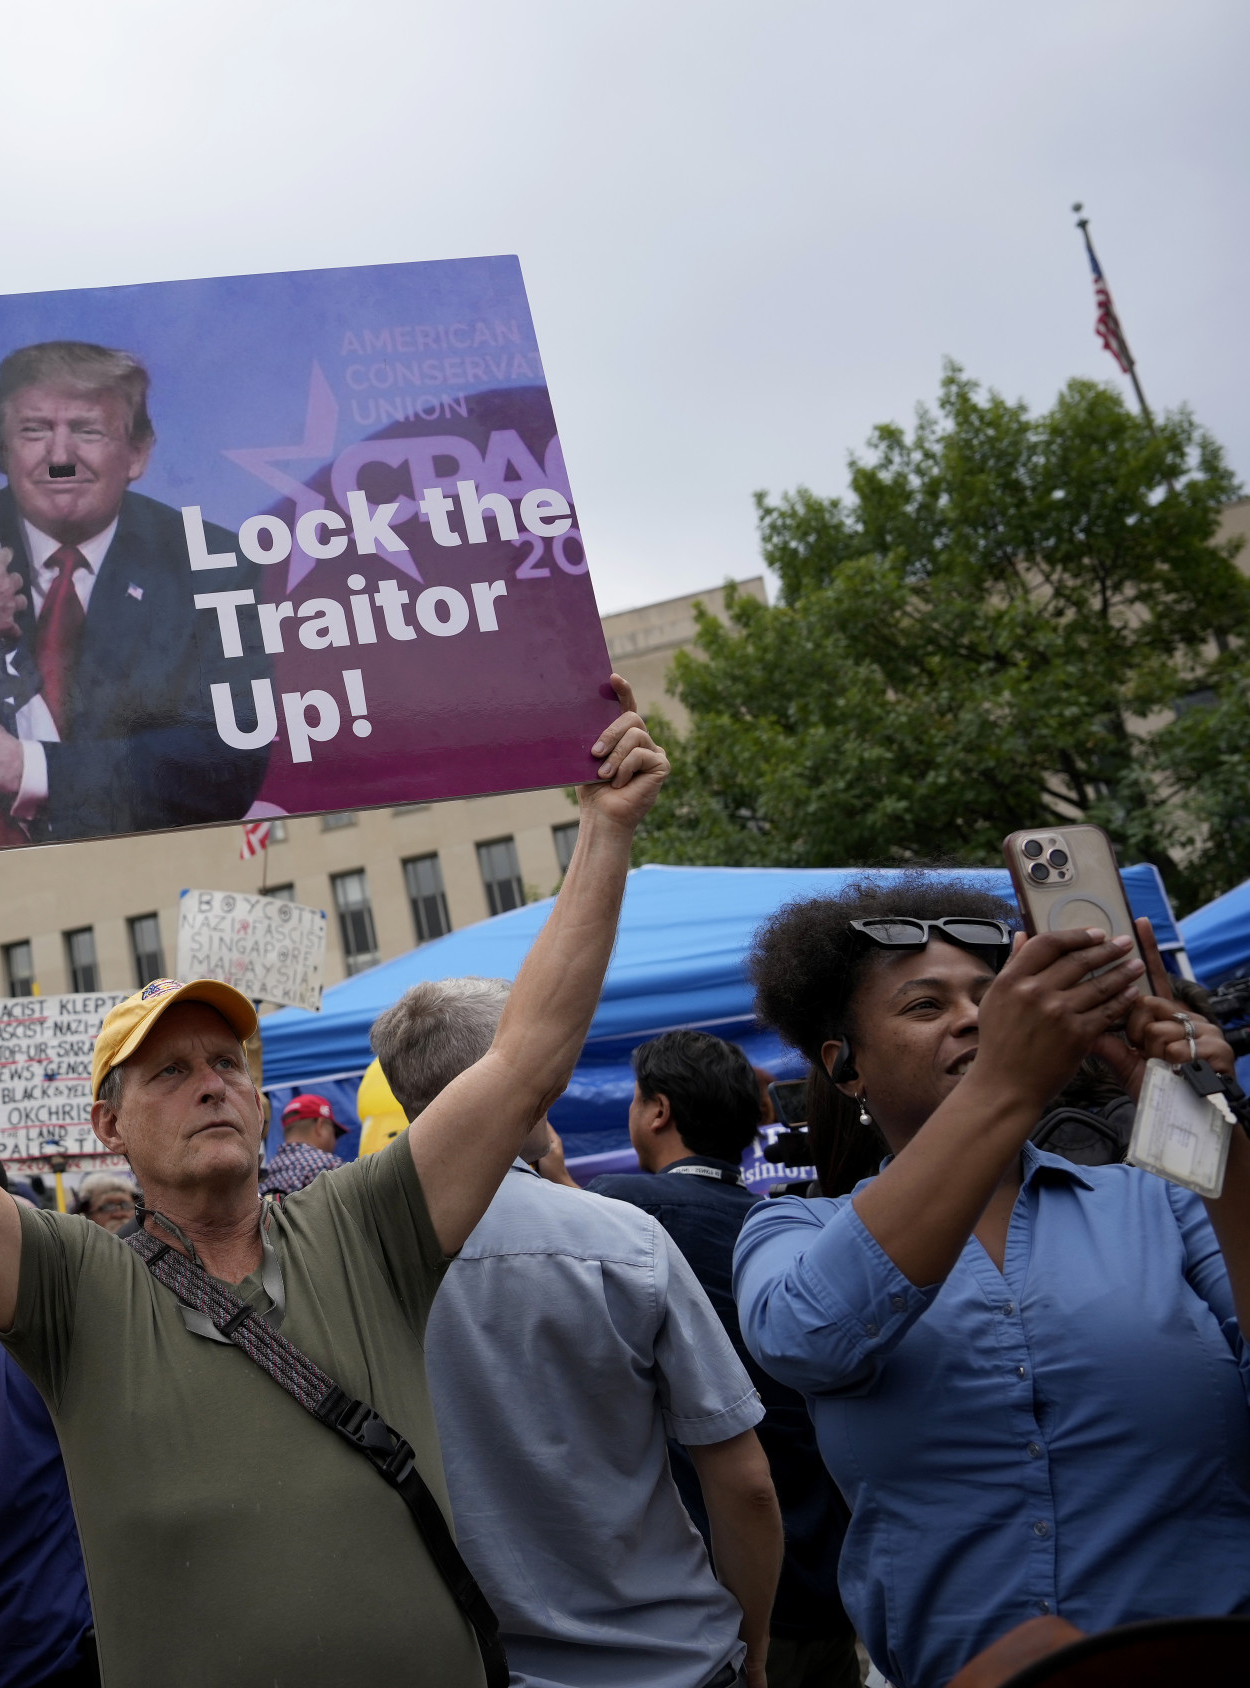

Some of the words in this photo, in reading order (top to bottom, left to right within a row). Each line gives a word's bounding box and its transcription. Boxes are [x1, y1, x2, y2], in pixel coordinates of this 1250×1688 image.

[340, 318, 523, 357] AMERICAN
[351, 391, 470, 426] UNION
[181, 489, 410, 571] Lock
[418, 479, 573, 548] the
[193, 573, 508, 659] Traitor
[209, 668, 373, 764] Up!
[2, 1084, 51, 1104] BLACK
[26, 1126, 68, 1142] LAND
